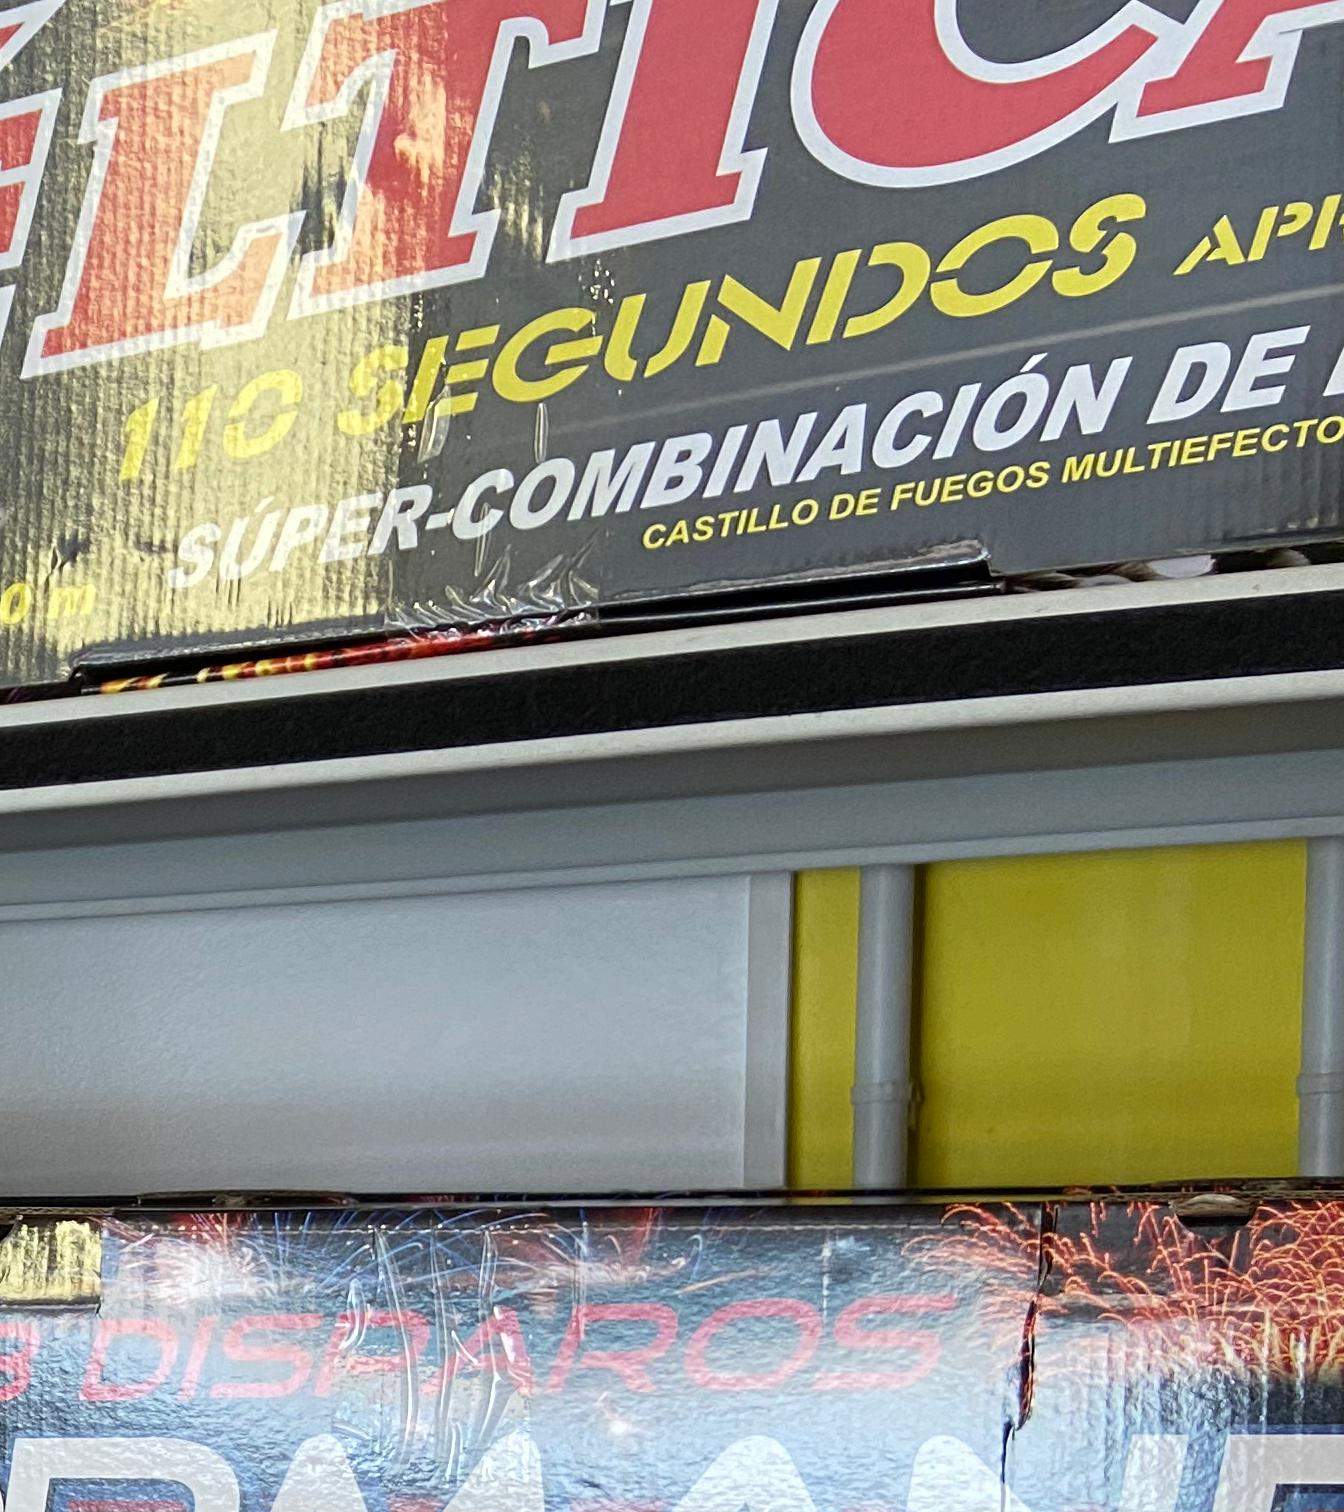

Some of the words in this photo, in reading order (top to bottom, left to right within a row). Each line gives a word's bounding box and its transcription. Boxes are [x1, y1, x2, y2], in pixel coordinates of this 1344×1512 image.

[117, 372, 305, 483] 110
[336, 192, 1147, 440] SEGUNDOS
[163, 352, 1138, 593] SÚPER-COMBINACIÓN
[1145, 324, 1311, 431] DE
[640, 497, 824, 551] CASTILLO
[827, 481, 885, 523] DE
[889, 459, 1053, 512] FUEGOS
[81, 1292, 958, 1403] DISPAROS
